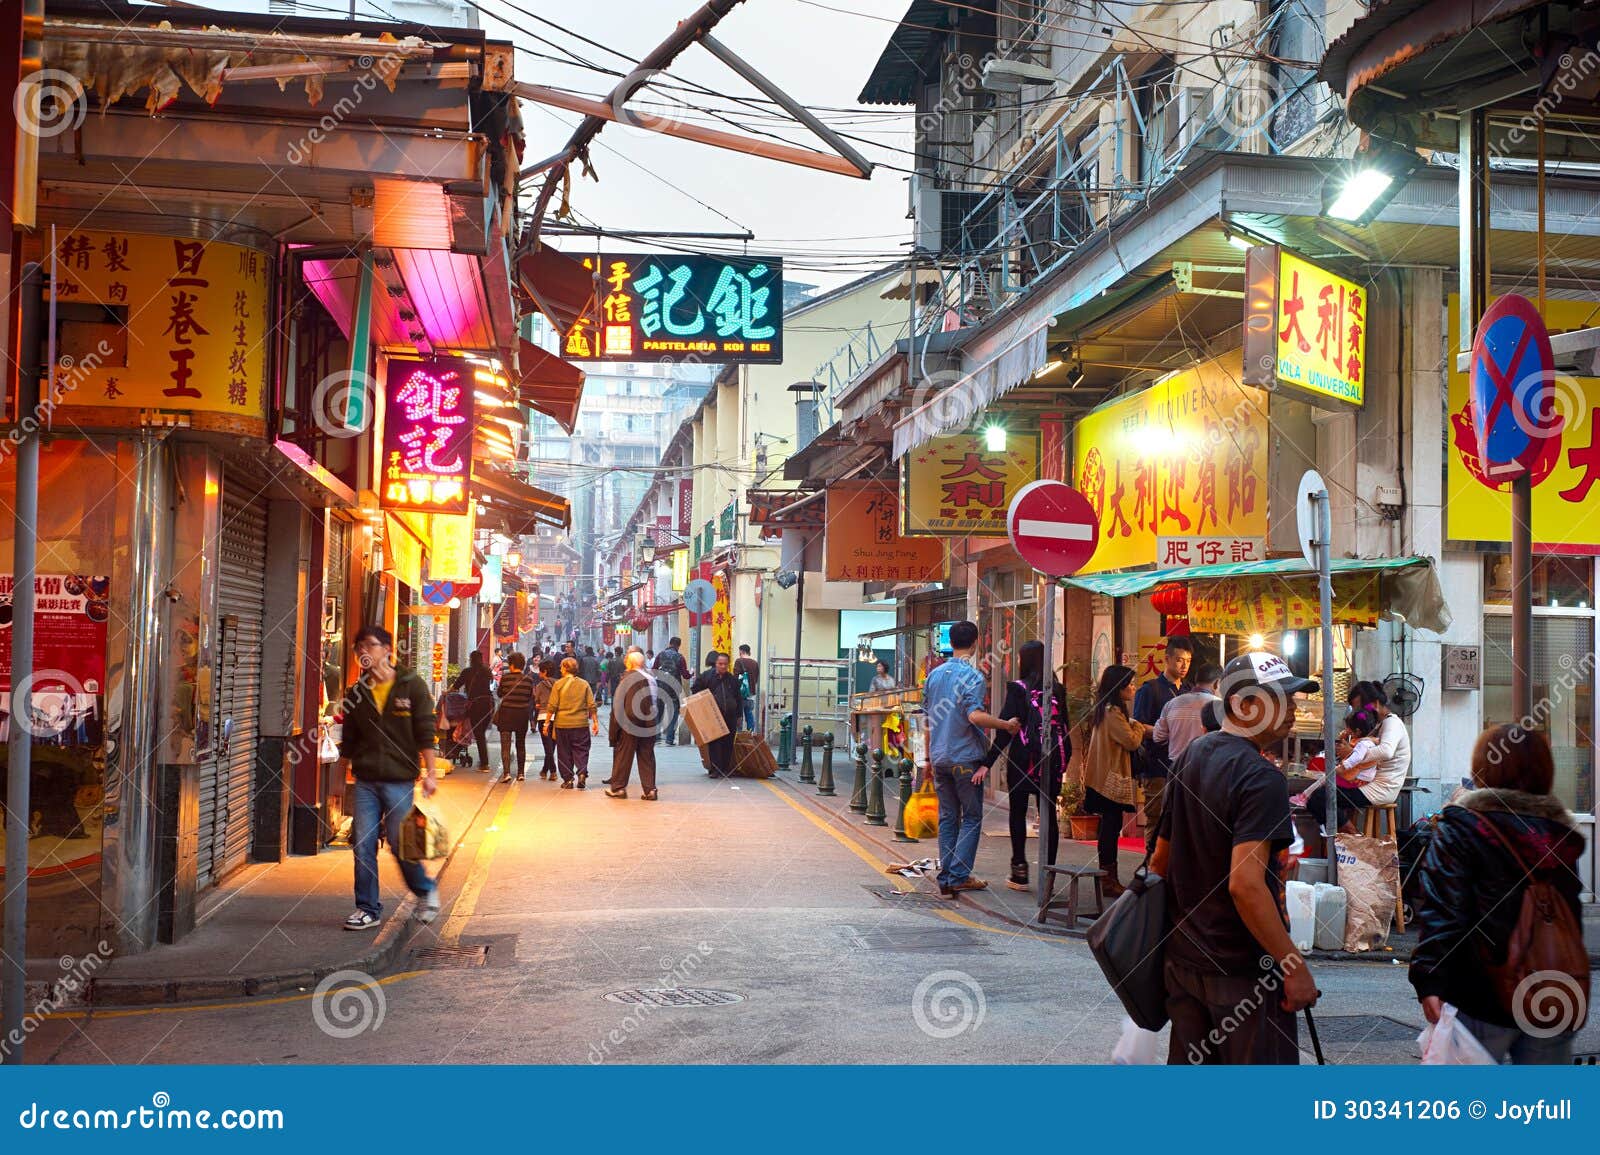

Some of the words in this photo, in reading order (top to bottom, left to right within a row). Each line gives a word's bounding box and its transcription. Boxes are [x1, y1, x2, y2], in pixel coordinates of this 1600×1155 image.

[643, 341, 717, 352] PASTELARIA
[723, 342, 745, 352] KOI
[751, 343, 771, 352] KEI
[1307, 369, 1362, 401] UNIVERSAL
[853, 548, 873, 558] Shui
[1163, 540, 1259, 566] 肥仔記
[839, 563, 933, 579] 大利洋酒手信
